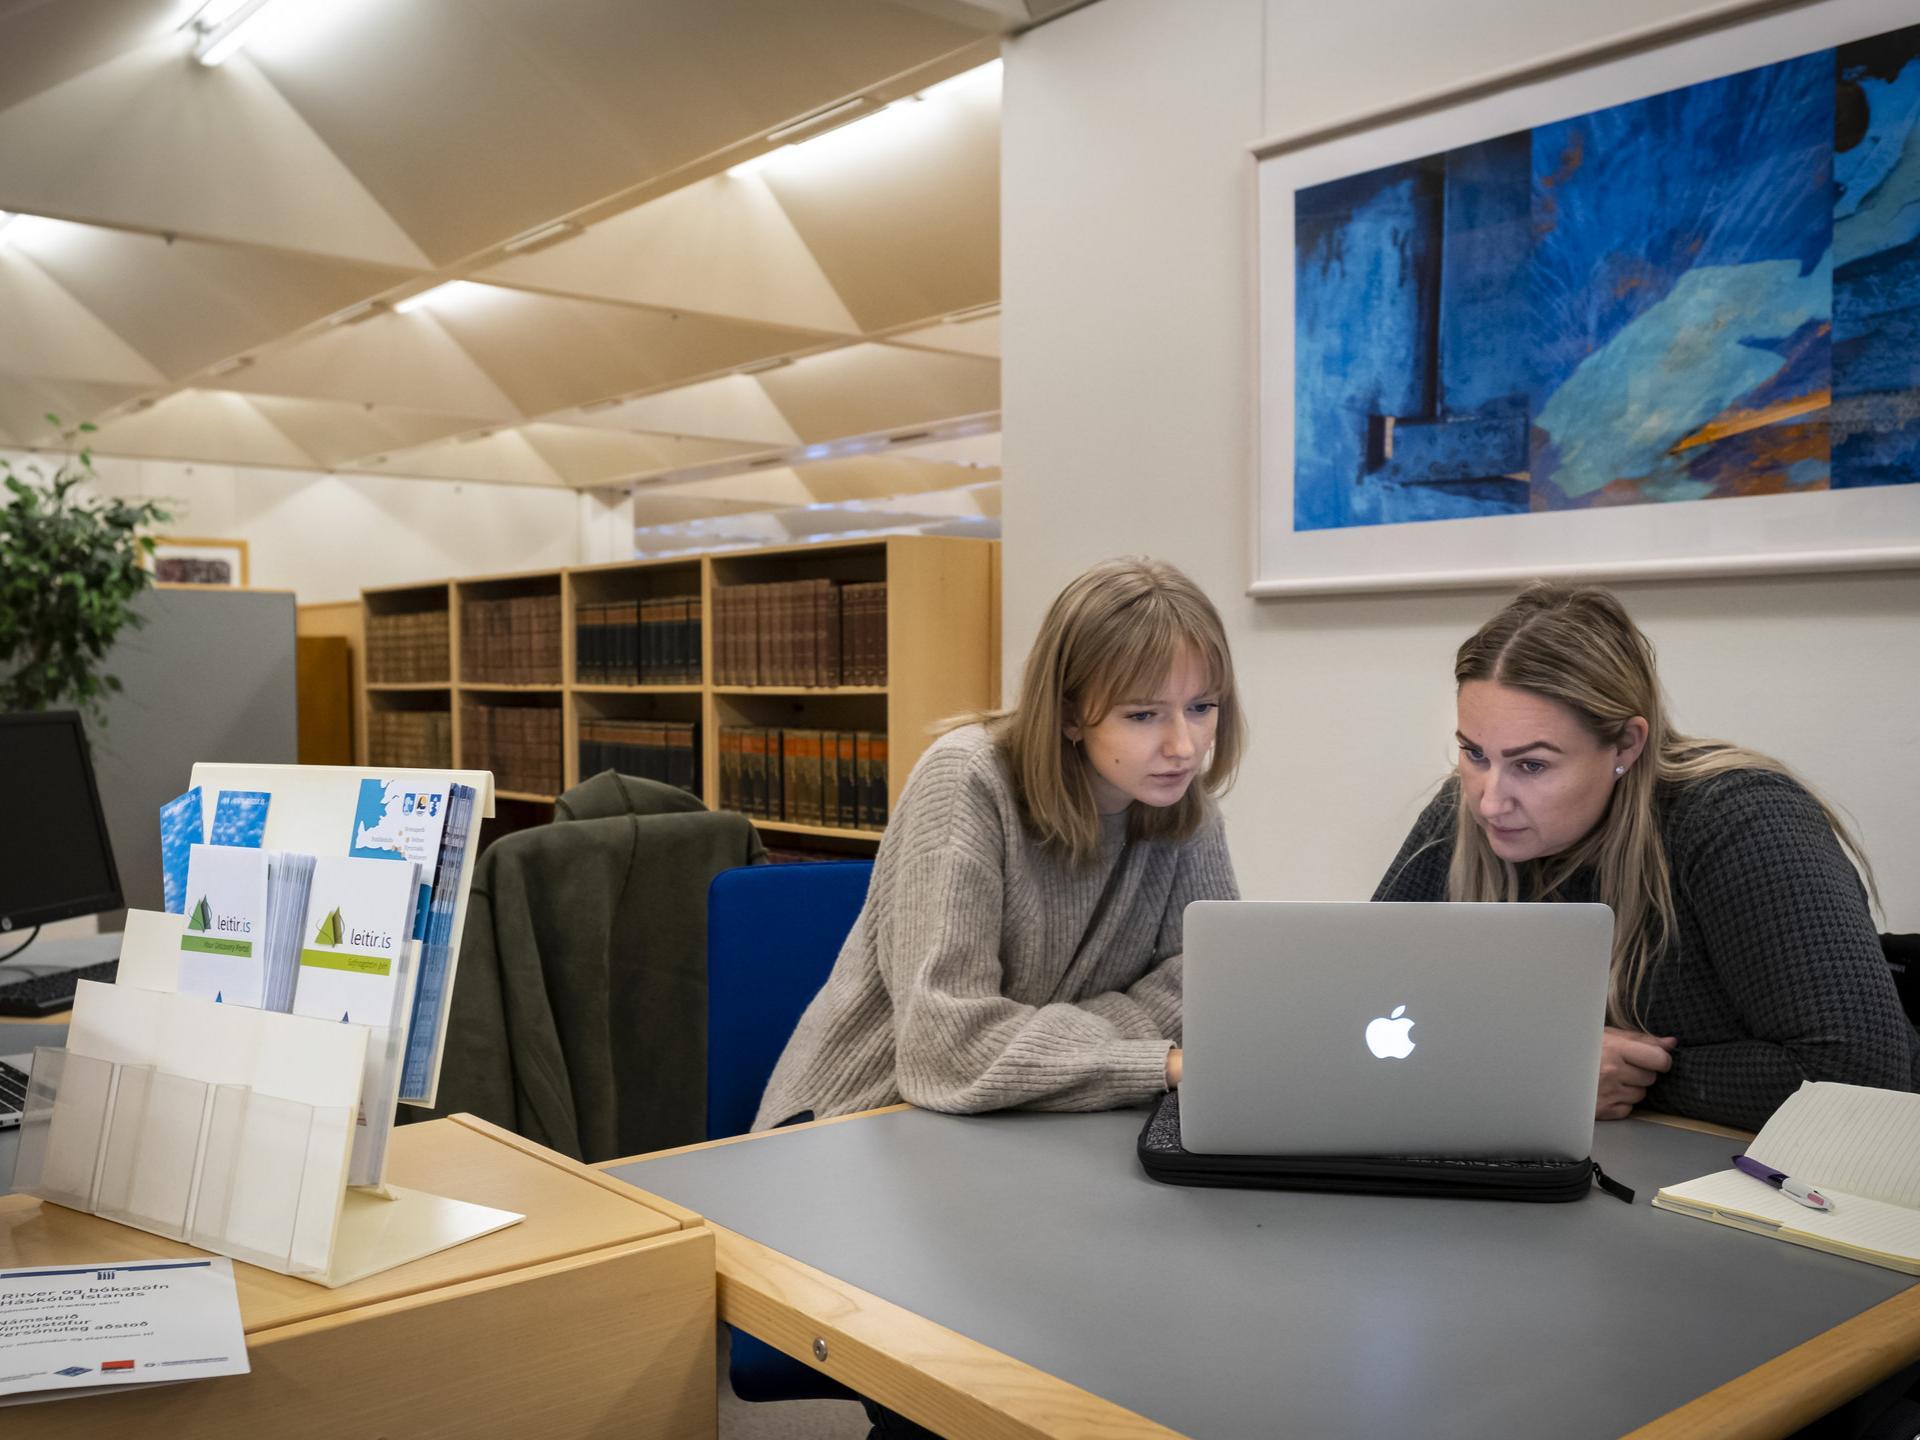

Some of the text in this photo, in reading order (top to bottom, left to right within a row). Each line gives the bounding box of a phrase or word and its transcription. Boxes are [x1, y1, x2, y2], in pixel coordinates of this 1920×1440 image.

[217, 915, 251, 933] leitir.is
[350, 929, 391, 949] leitir.is
[2, 1291, 56, 1300] Ritver
